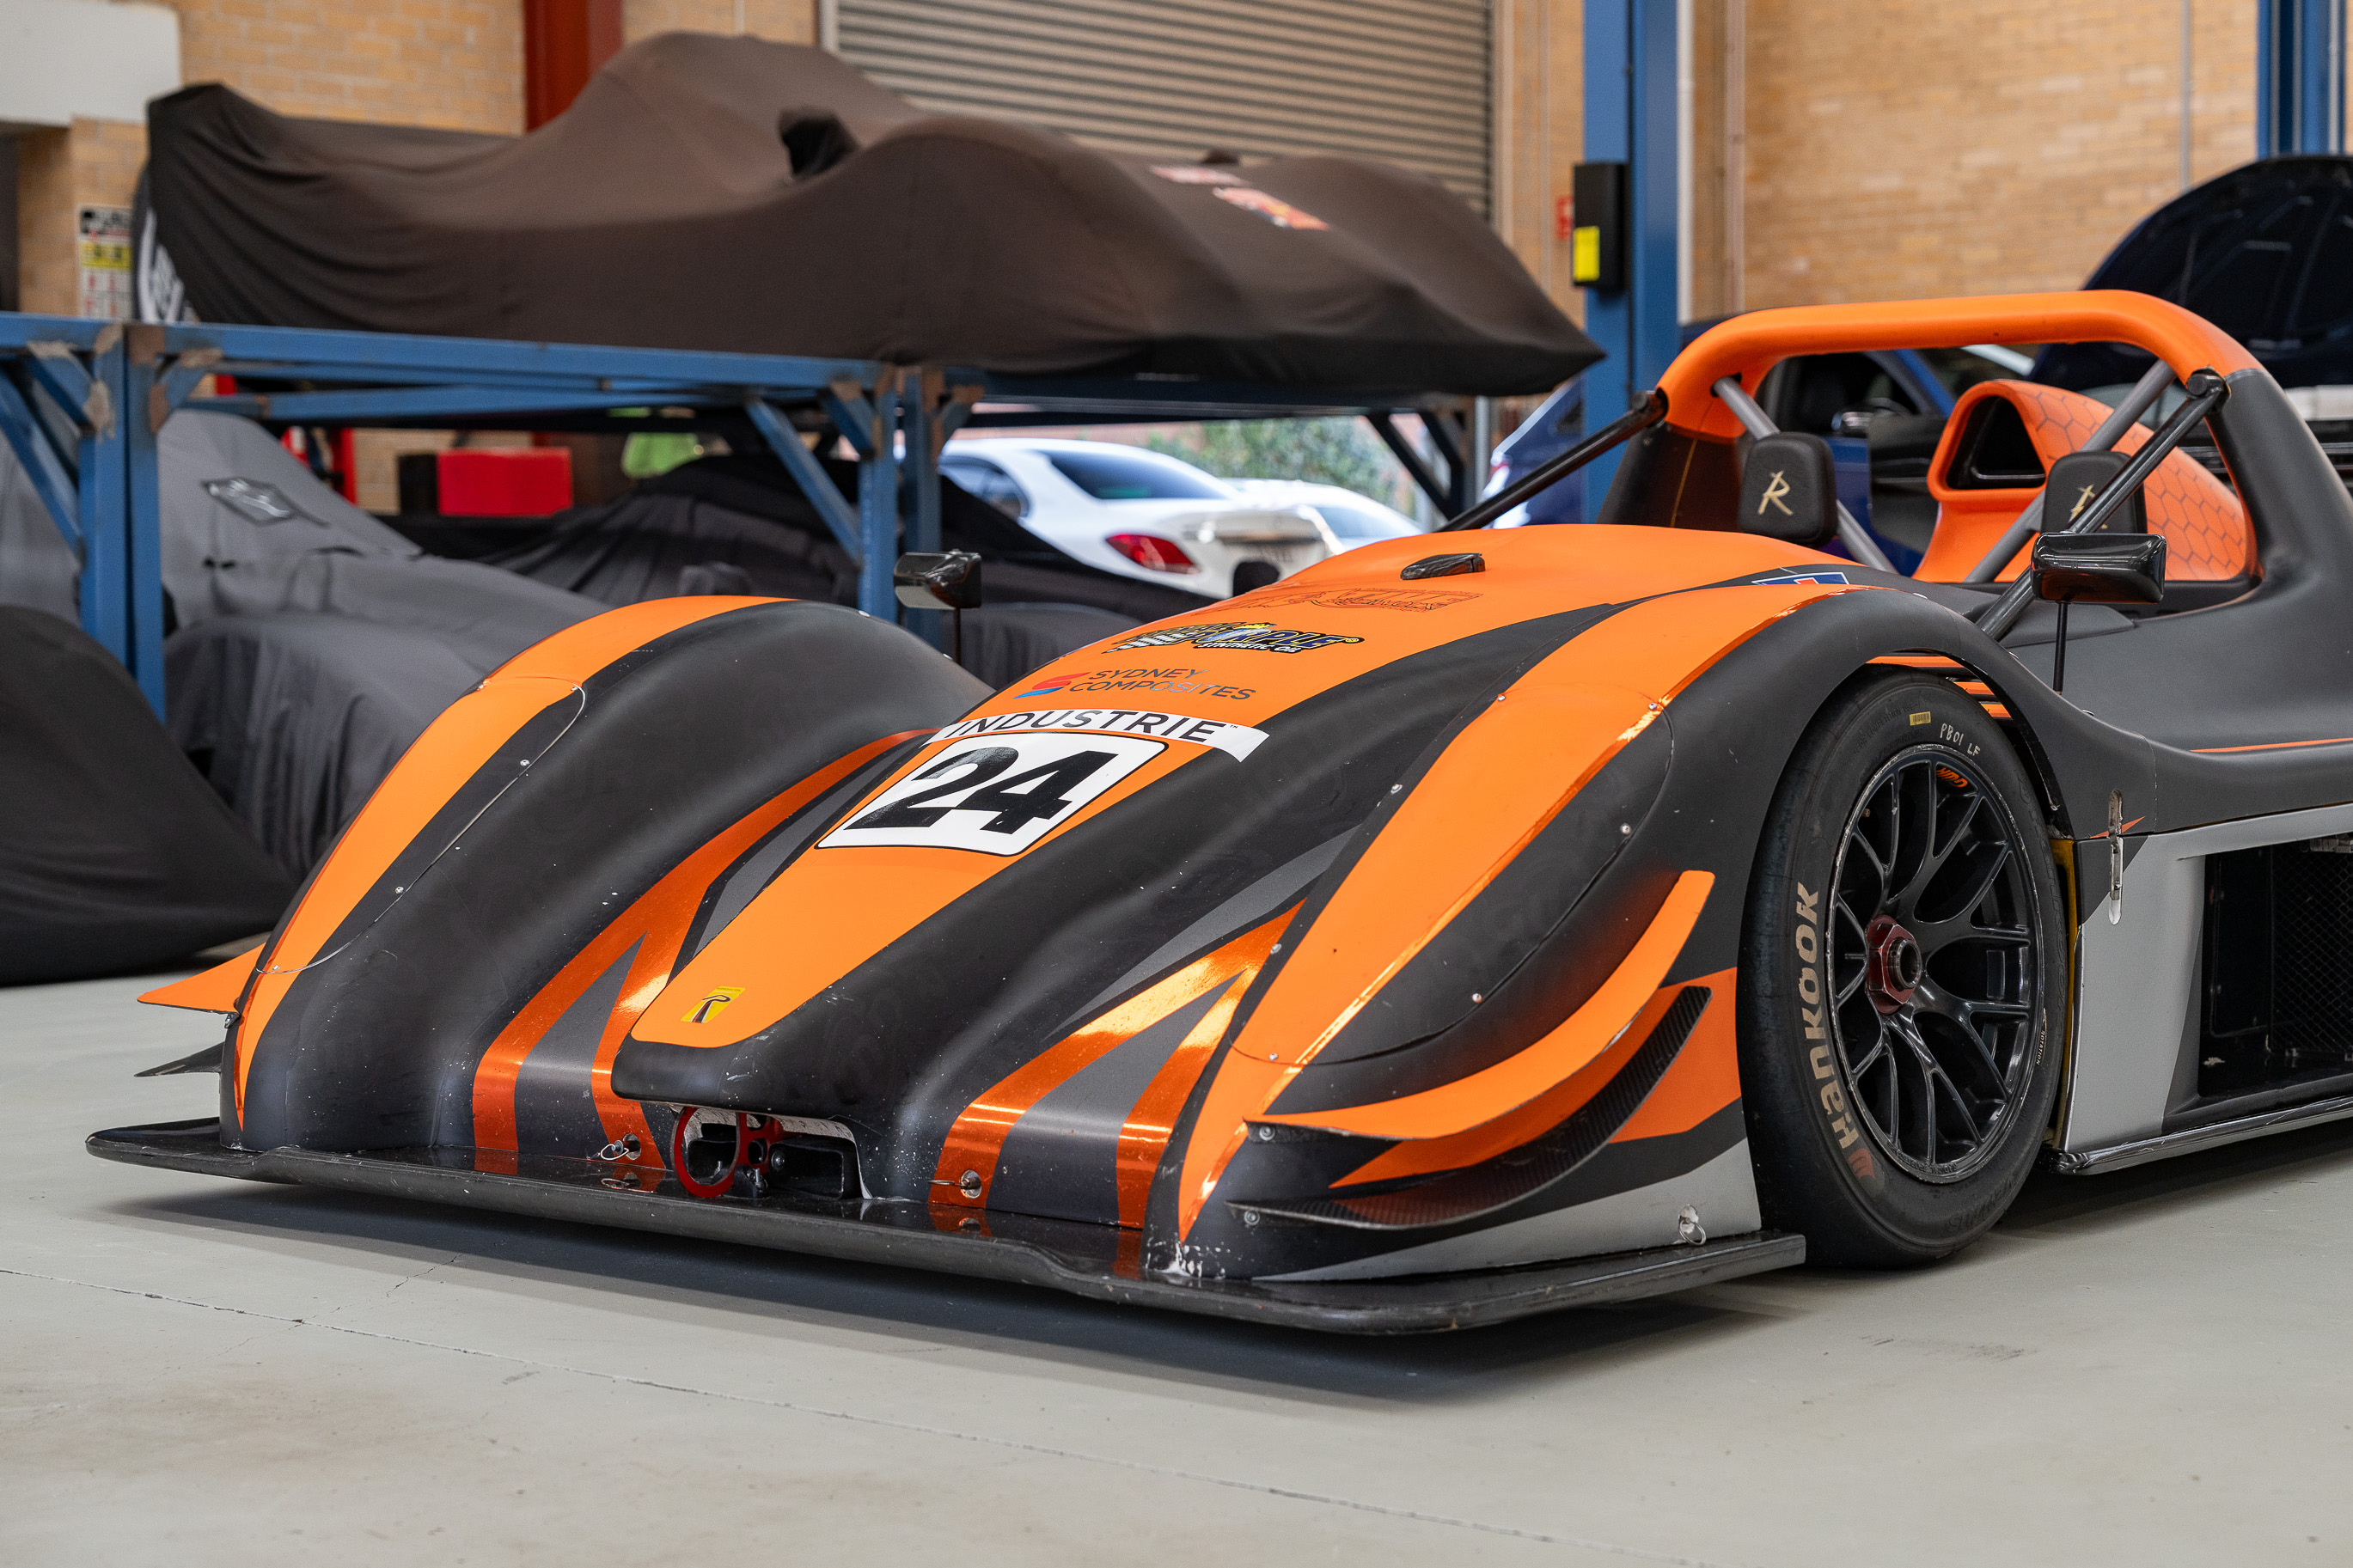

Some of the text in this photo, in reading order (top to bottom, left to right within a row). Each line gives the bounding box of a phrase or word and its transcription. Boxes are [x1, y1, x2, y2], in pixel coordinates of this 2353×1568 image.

[1089, 668, 1208, 680] SYDNEY
[1070, 680, 1257, 701] COMPOSITES
[944, 710, 1227, 742] INDUSTRIE
[1966, 742, 1981, 756] LF
[842, 746, 1120, 835] 24
[2036, 1029, 2045, 1065] ROTATION
